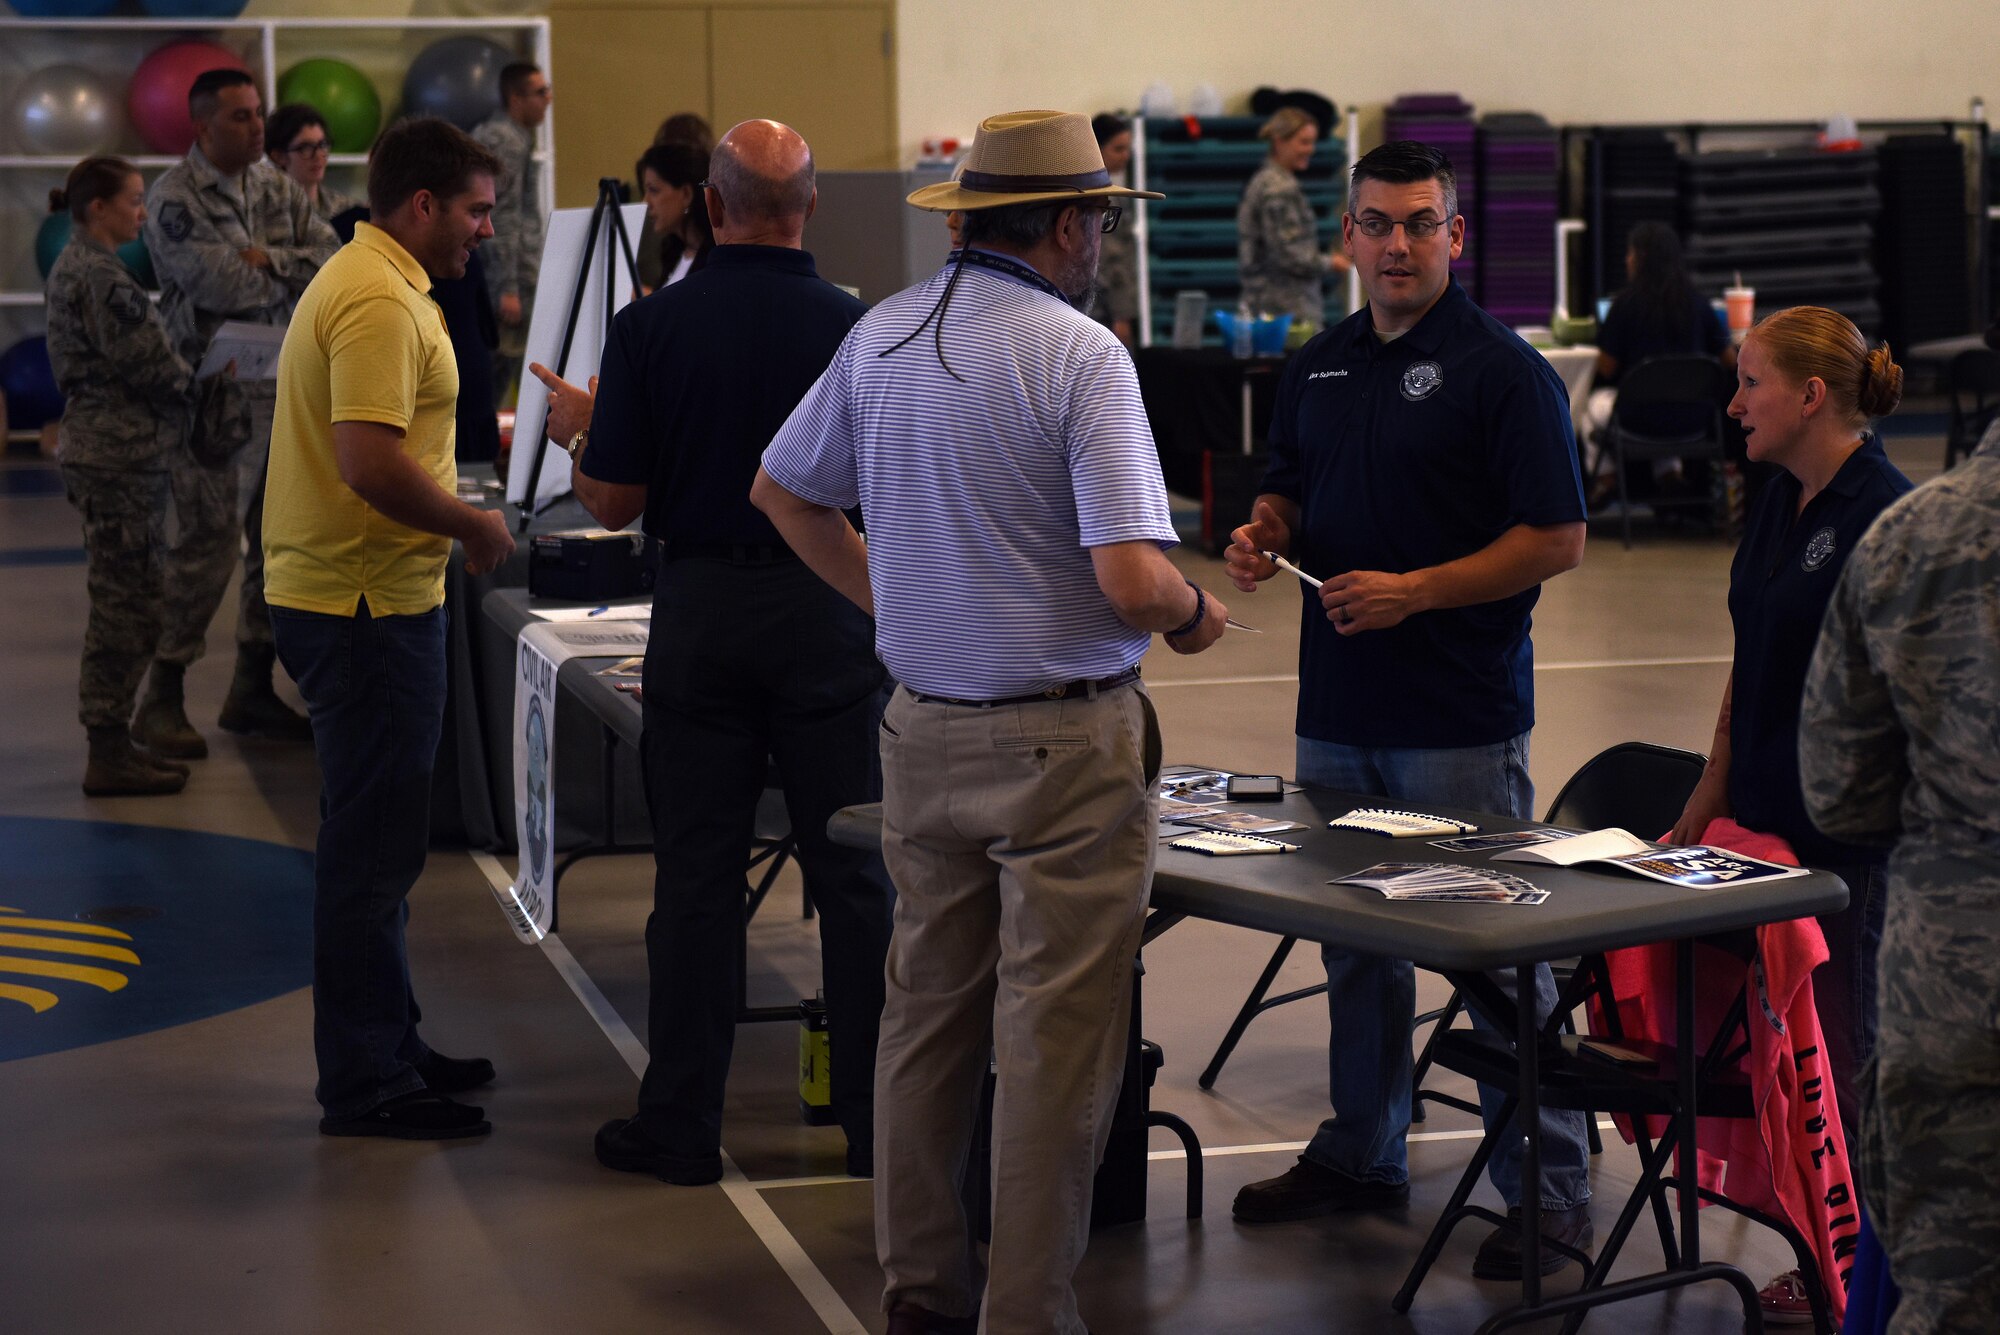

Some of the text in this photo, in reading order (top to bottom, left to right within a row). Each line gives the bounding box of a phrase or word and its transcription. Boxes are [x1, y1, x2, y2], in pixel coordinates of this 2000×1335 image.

[522, 642, 552, 703] CIVIL AIR
[1703, 858, 1755, 871] ARE
[1794, 1046, 1836, 1170] LOVE
